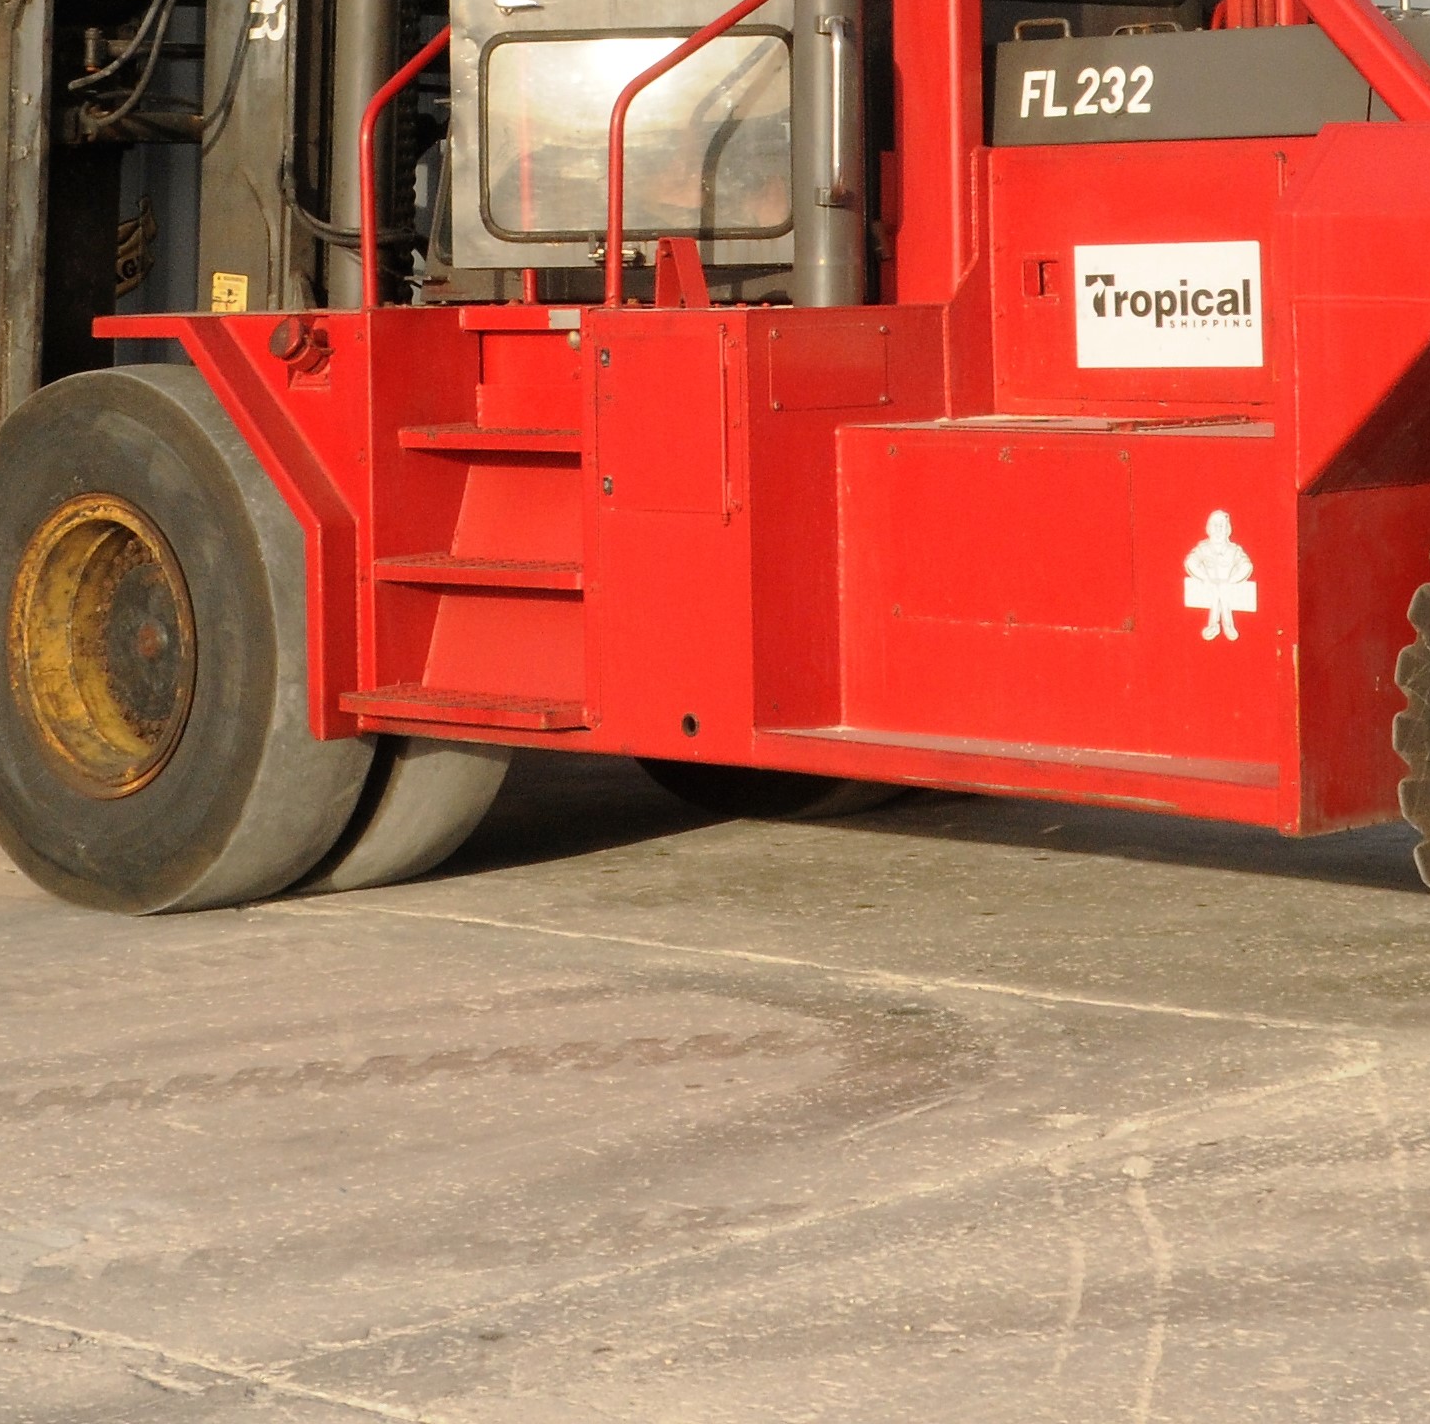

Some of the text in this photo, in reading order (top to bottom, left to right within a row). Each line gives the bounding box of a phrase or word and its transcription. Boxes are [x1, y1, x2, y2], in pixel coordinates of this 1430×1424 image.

[1020, 65, 1155, 118] FL 232
[1084, 274, 1252, 329] Tropical
[1169, 318, 1253, 329] SHIPPING
